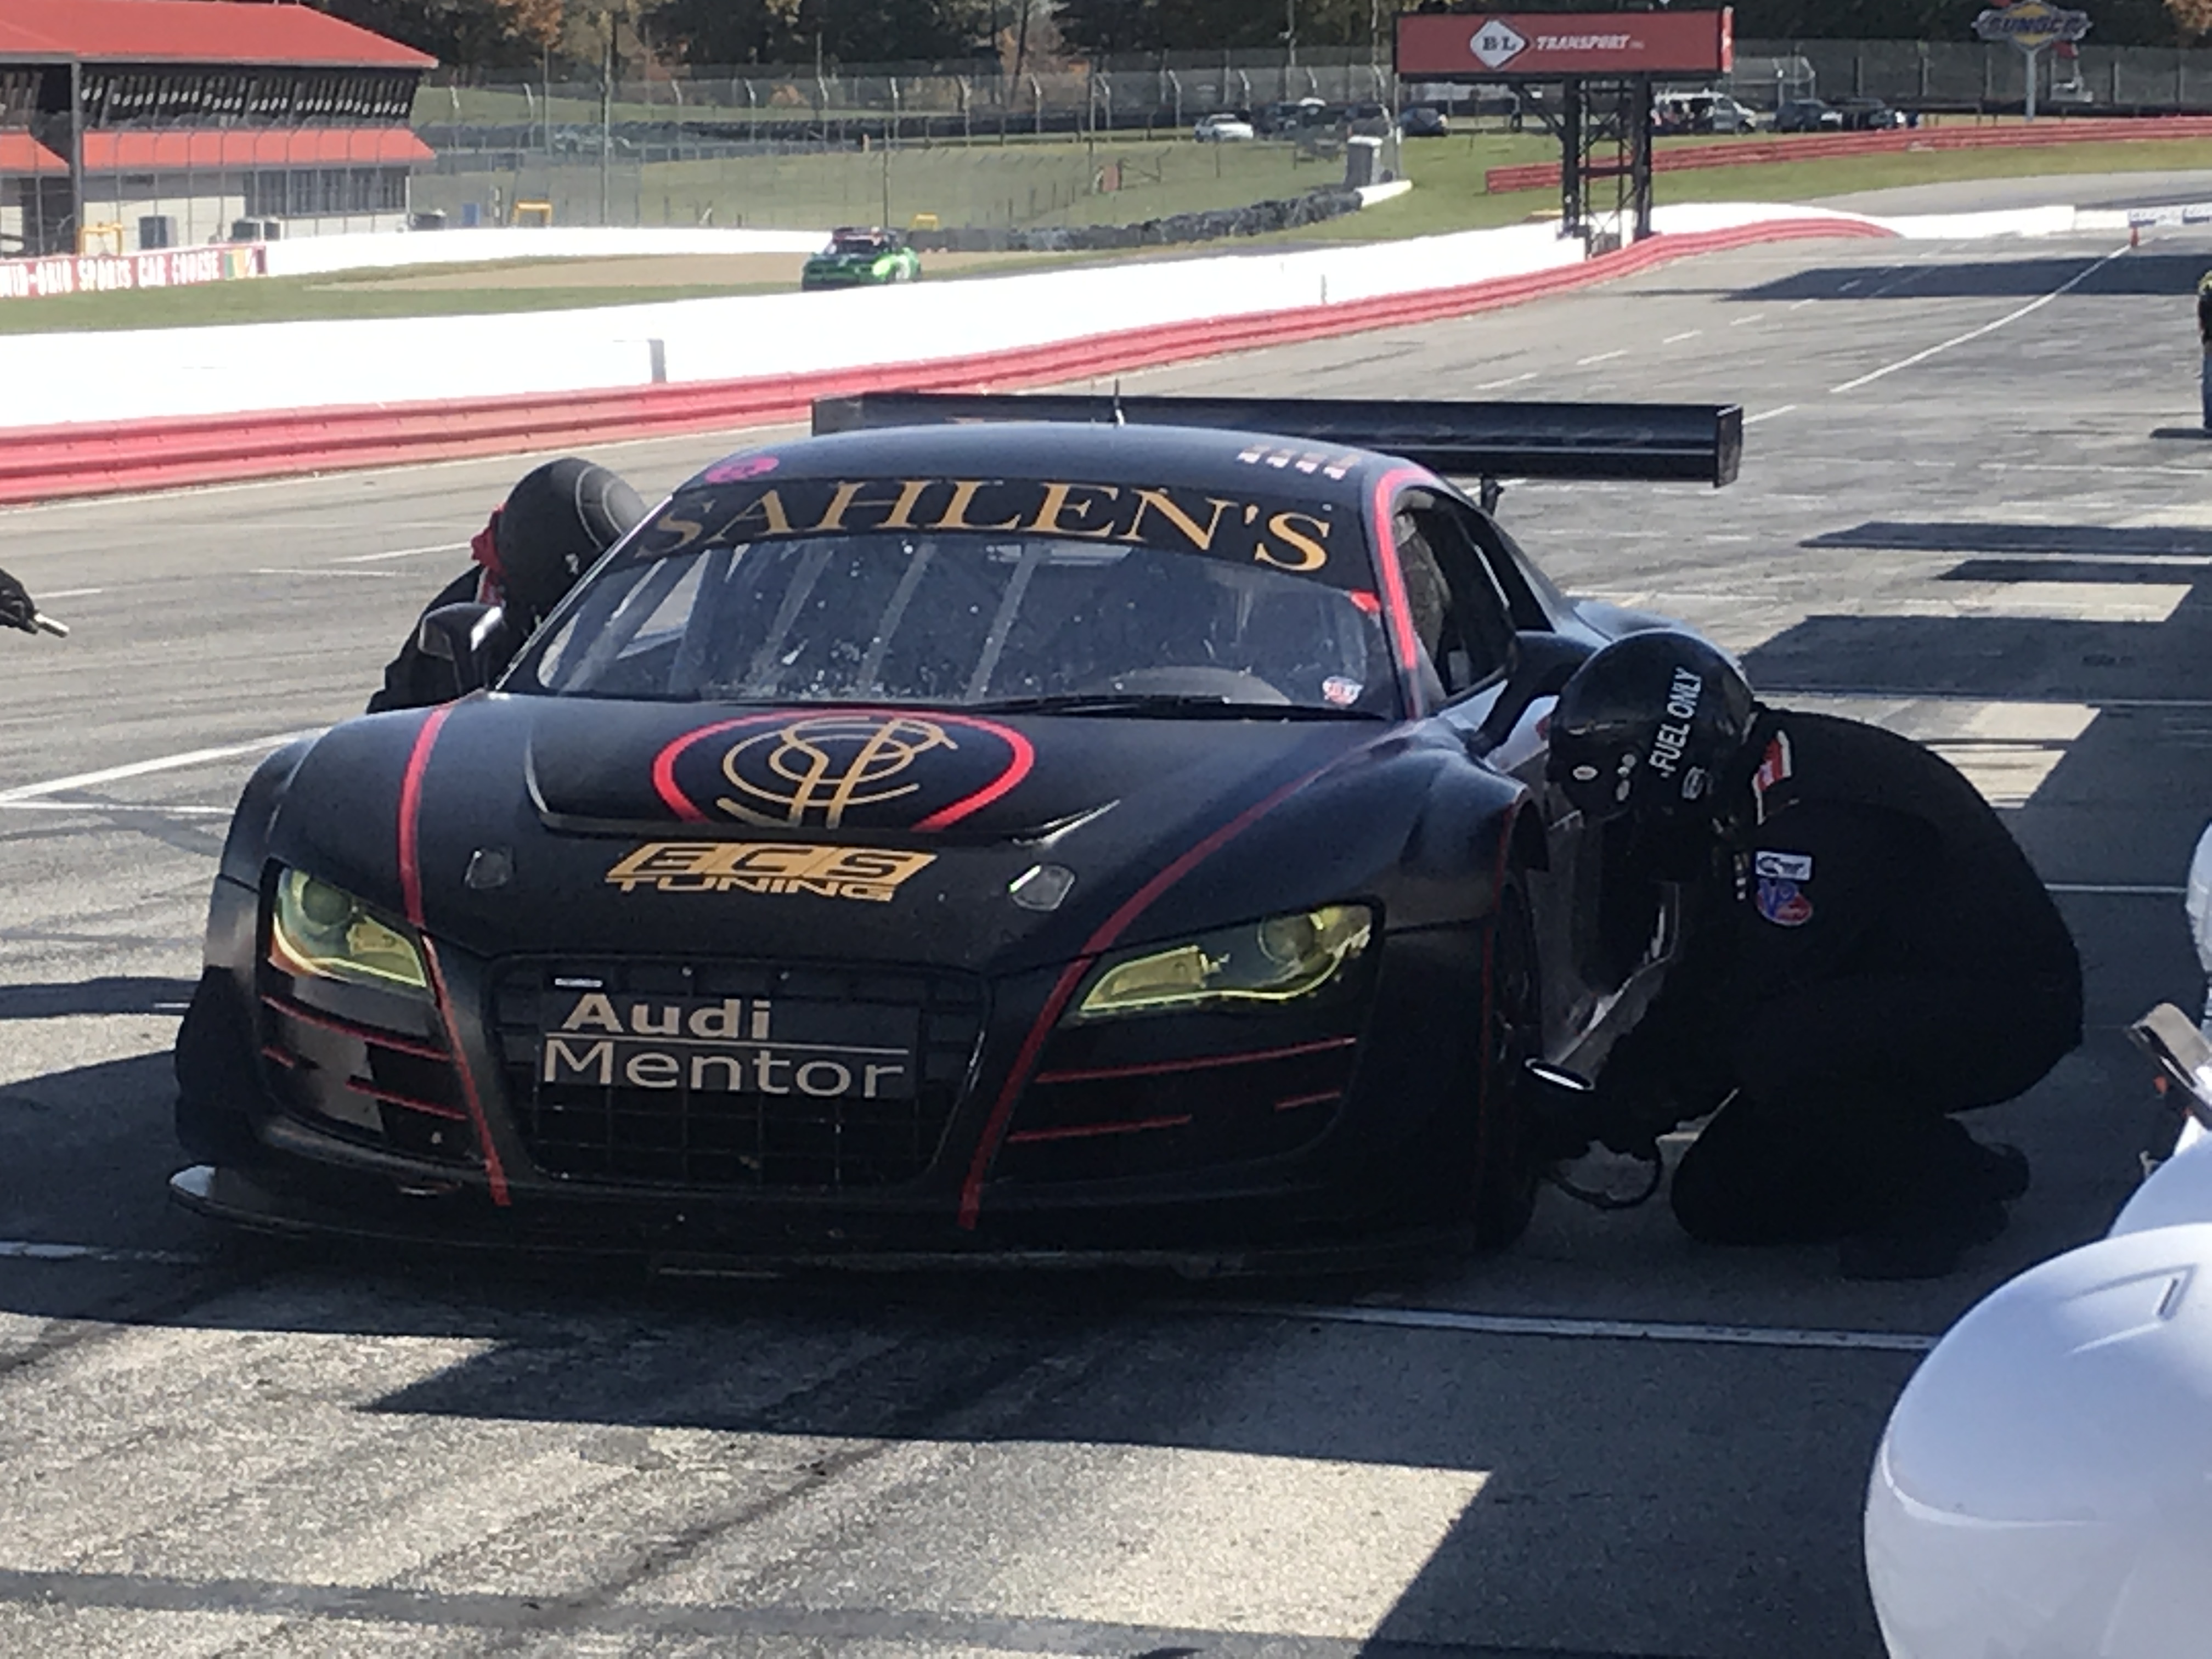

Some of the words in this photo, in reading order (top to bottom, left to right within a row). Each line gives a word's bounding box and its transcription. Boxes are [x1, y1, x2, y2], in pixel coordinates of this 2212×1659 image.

[1537, 34, 1630, 50] TRANSPORT
[78, 259, 132, 291] SPORTS
[138, 256, 165, 287] CAR
[171, 251, 219, 285] COURSE
[635, 480, 1333, 573] SAHLEN'S
[1667, 666, 1702, 719] ONLY
[1649, 722, 1691, 772] FUEL
[620, 843, 927, 882] ECS
[613, 877, 895, 901] TUNING
[562, 994, 770, 1039] Audi
[543, 1041, 904, 1098] Mentor
